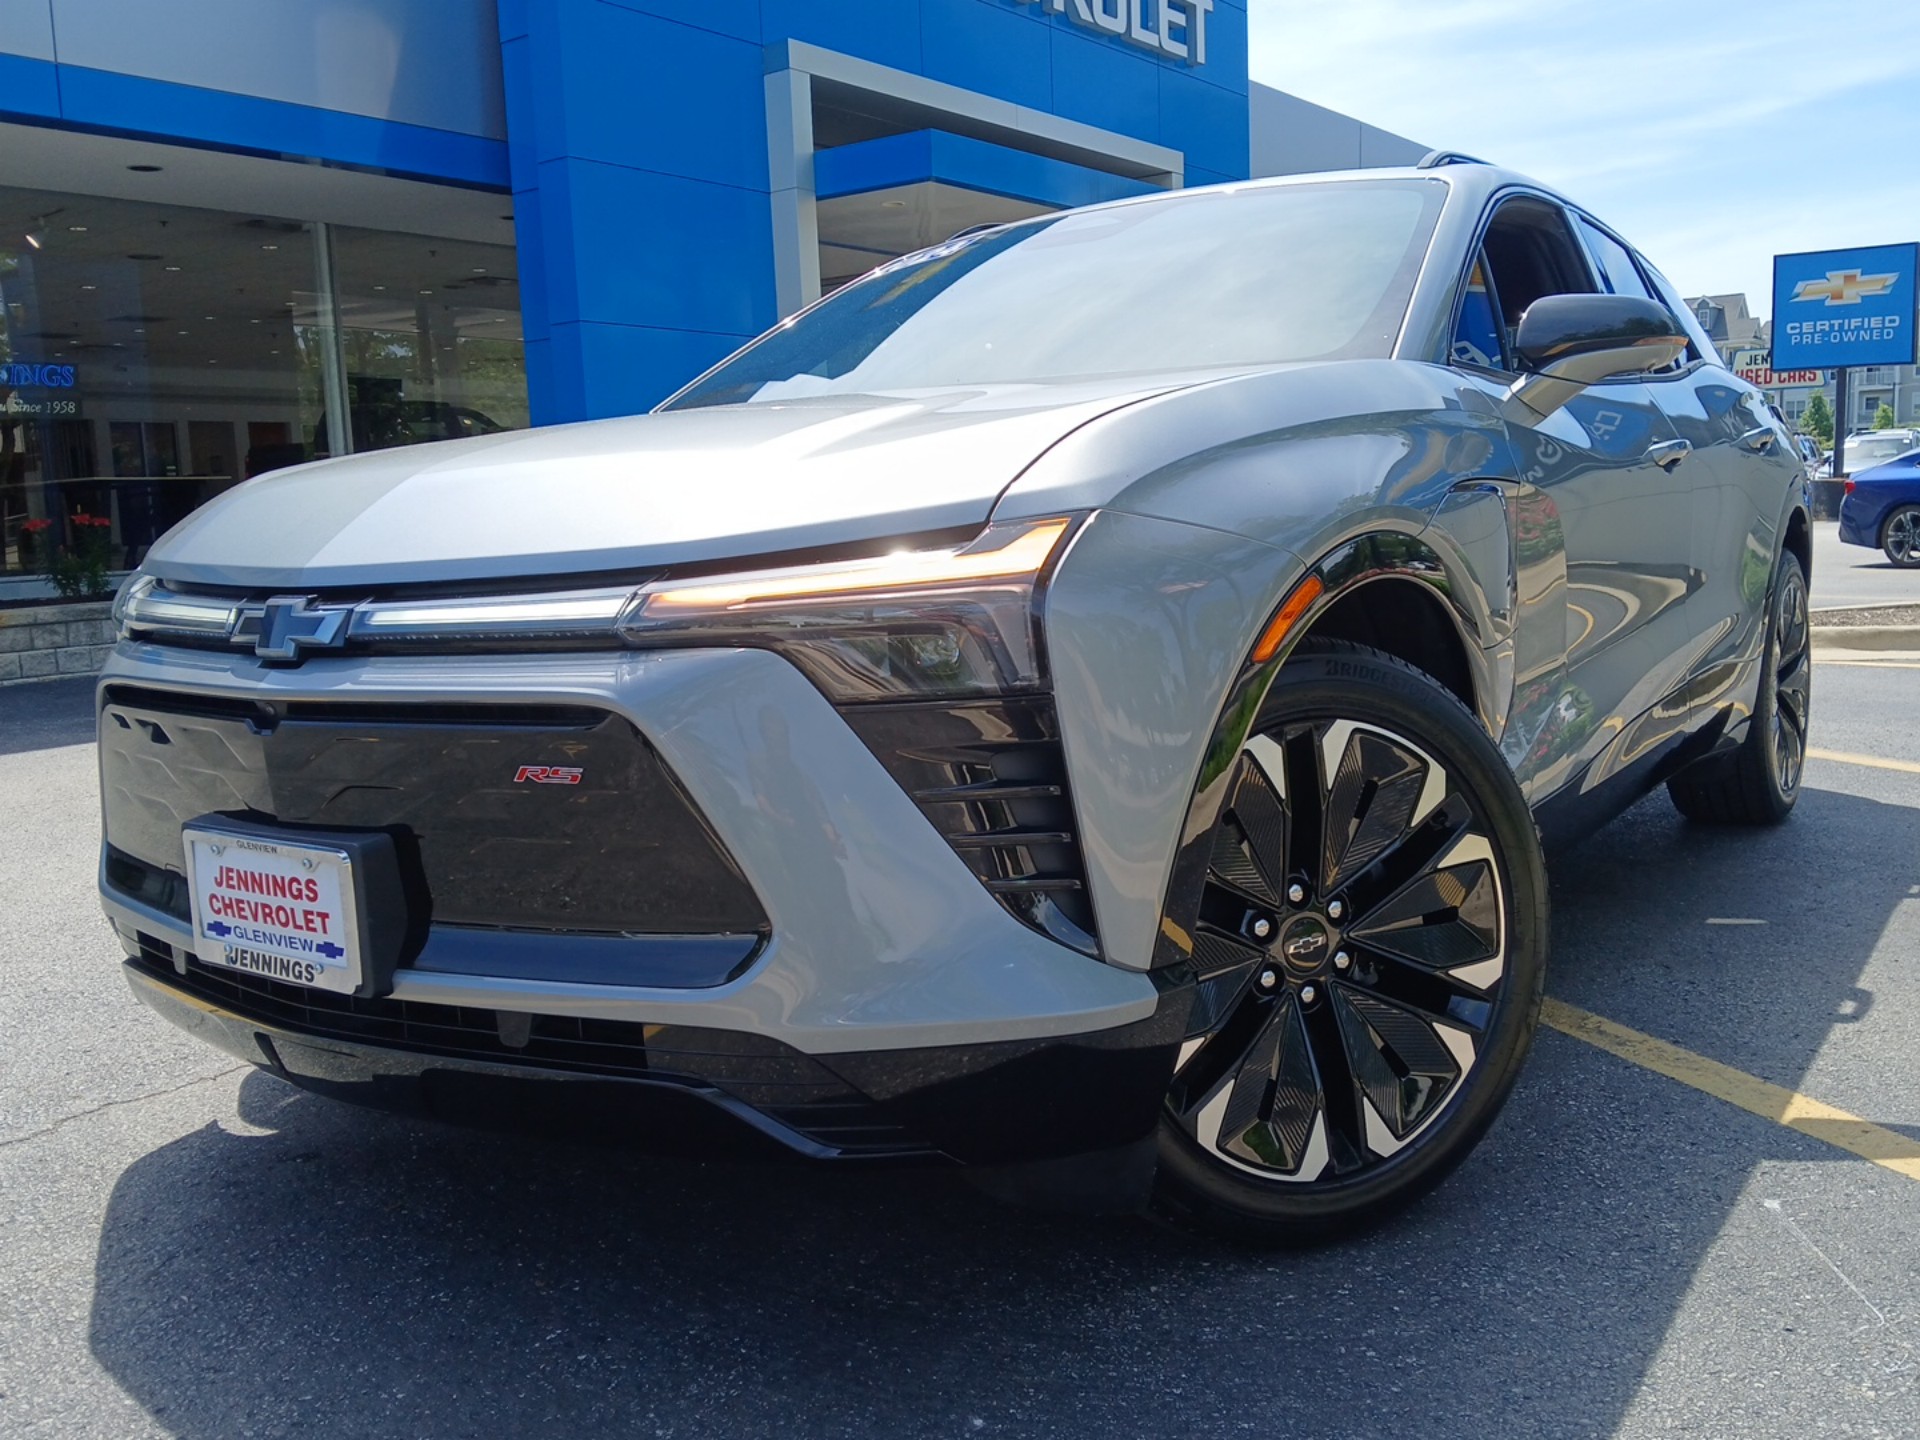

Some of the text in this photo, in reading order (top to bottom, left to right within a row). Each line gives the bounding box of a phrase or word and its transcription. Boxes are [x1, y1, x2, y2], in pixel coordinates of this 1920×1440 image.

[1786, 315, 1900, 334] CERTIFIED
[1791, 328, 1894, 346] PRE-OWNED
[1778, 371, 1817, 383] CARS
[46, 401, 76, 414] 1958
[1325, 658, 1434, 702] BRIDGESTO
[513, 765, 584, 785] RS
[236, 840, 278, 854] GLENVIEW
[214, 865, 319, 903] JENNINGS
[208, 893, 330, 935] CHEVROLET
[233, 925, 314, 953] GLENVIEW
[229, 947, 315, 983] JENNINGS
